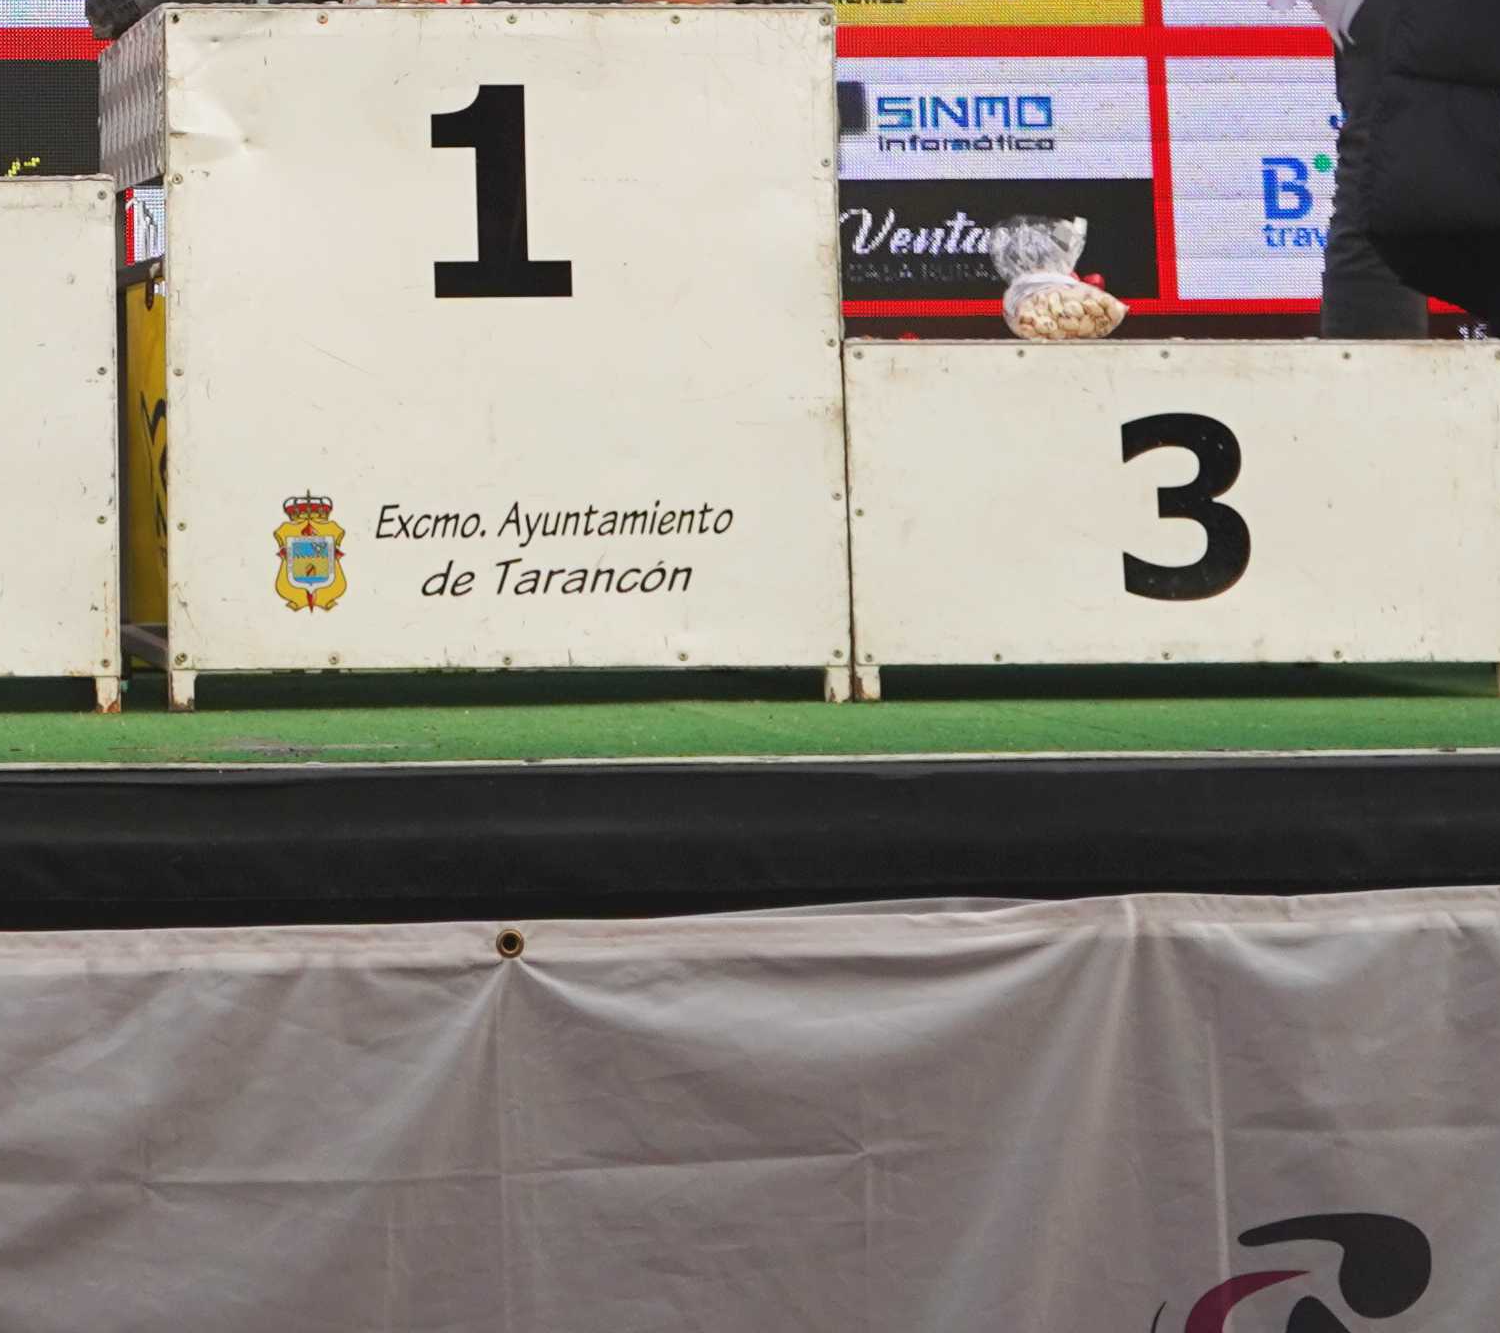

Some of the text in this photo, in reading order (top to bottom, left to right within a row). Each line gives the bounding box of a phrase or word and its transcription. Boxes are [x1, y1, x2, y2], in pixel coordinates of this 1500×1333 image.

[430, 84, 573, 298] 1
[375, 500, 734, 547] Excmo. Ayuntamiento
[1120, 412, 1251, 601] 3
[421, 558, 692, 597] de Tarancón
